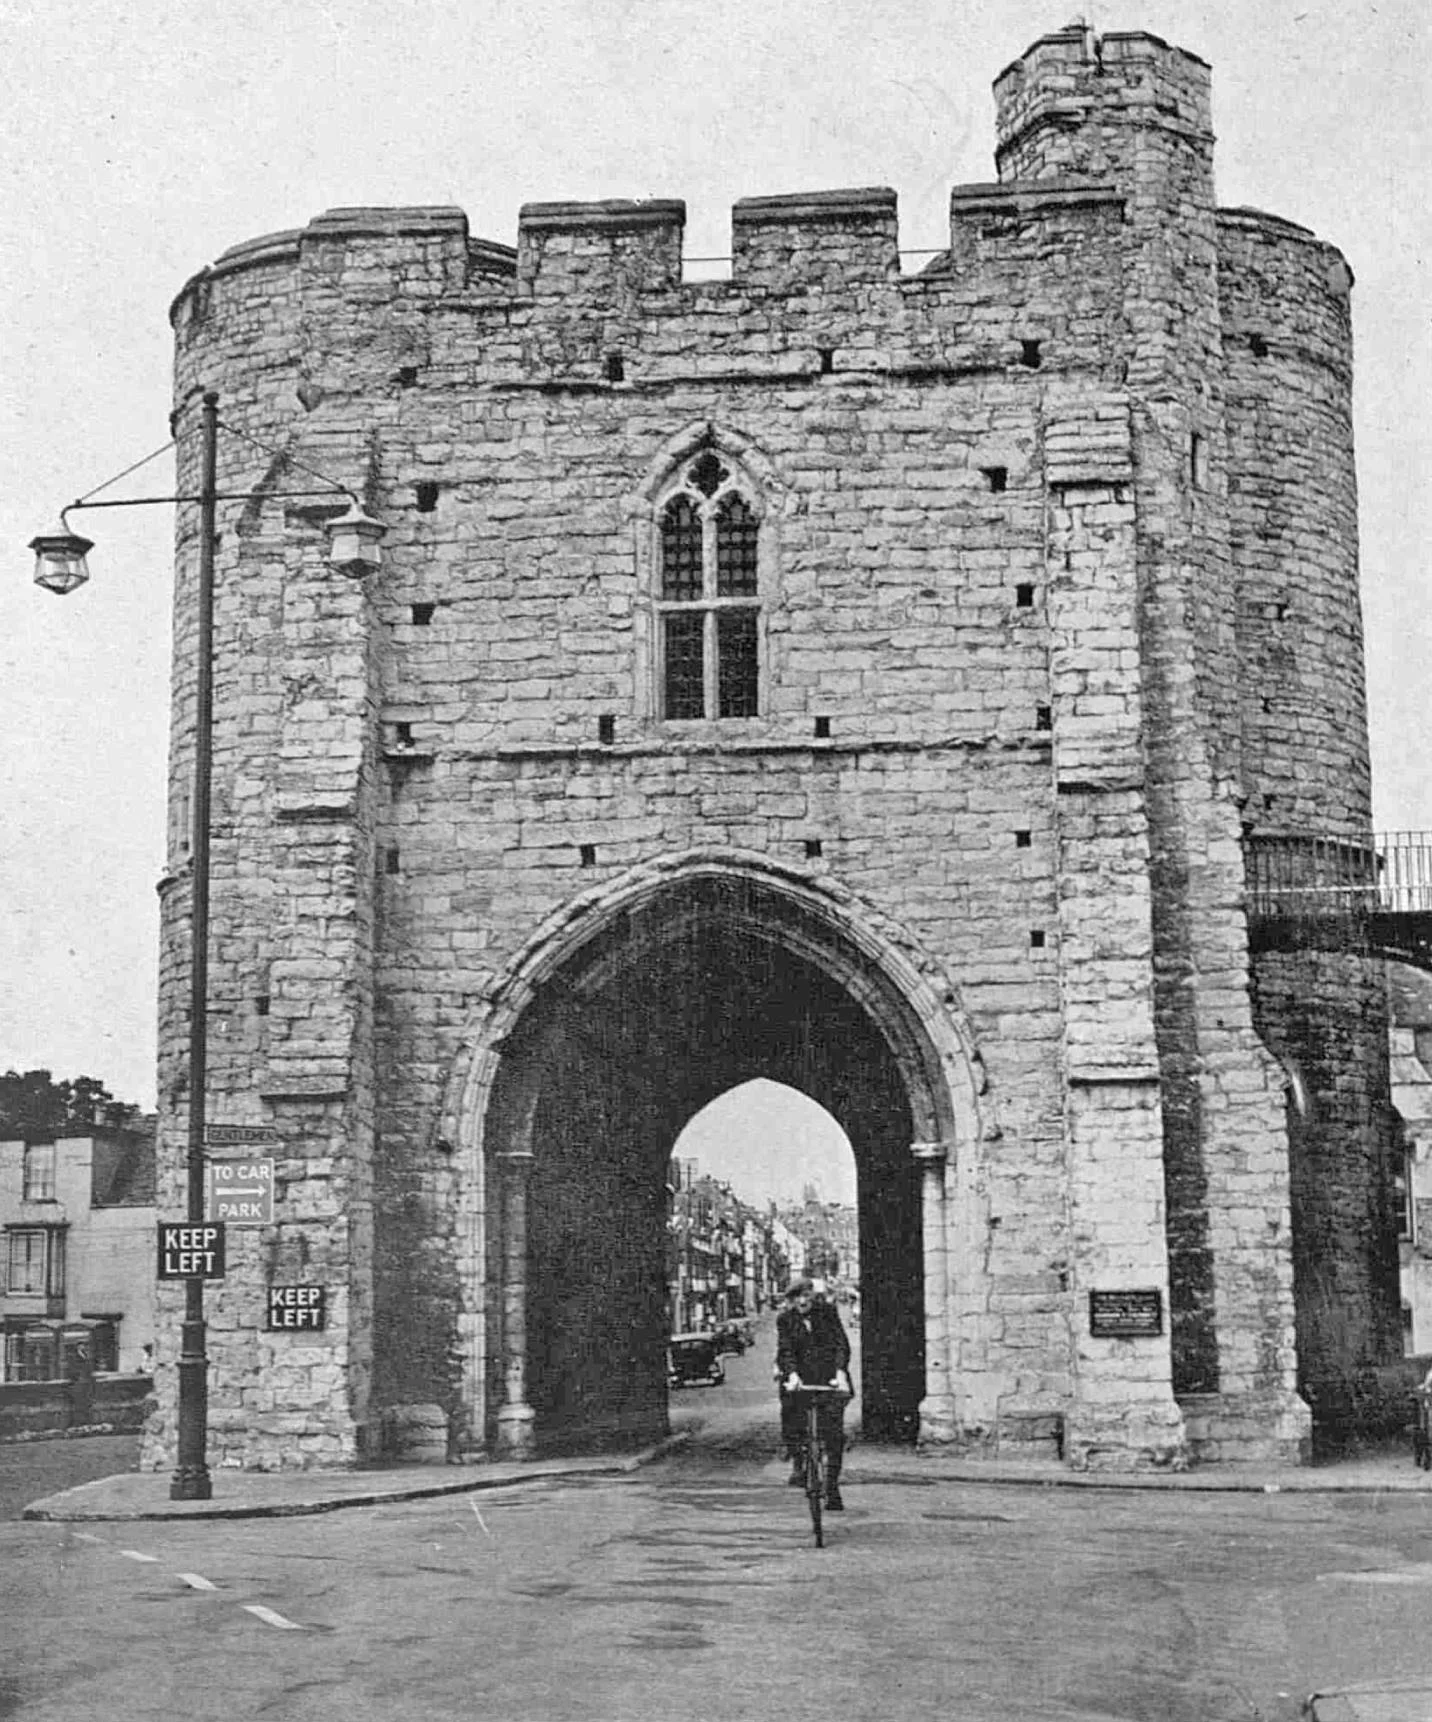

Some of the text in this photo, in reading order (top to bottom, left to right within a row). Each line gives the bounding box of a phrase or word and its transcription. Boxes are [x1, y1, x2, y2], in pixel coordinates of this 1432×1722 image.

[213, 1165, 270, 1180] TO CAR
[218, 1203, 262, 1218] PARK
[164, 1228, 217, 1250] KEEP
[164, 1252, 215, 1273] LEFT
[271, 1288, 321, 1306] KEEP
[271, 1309, 320, 1327] LEFT
